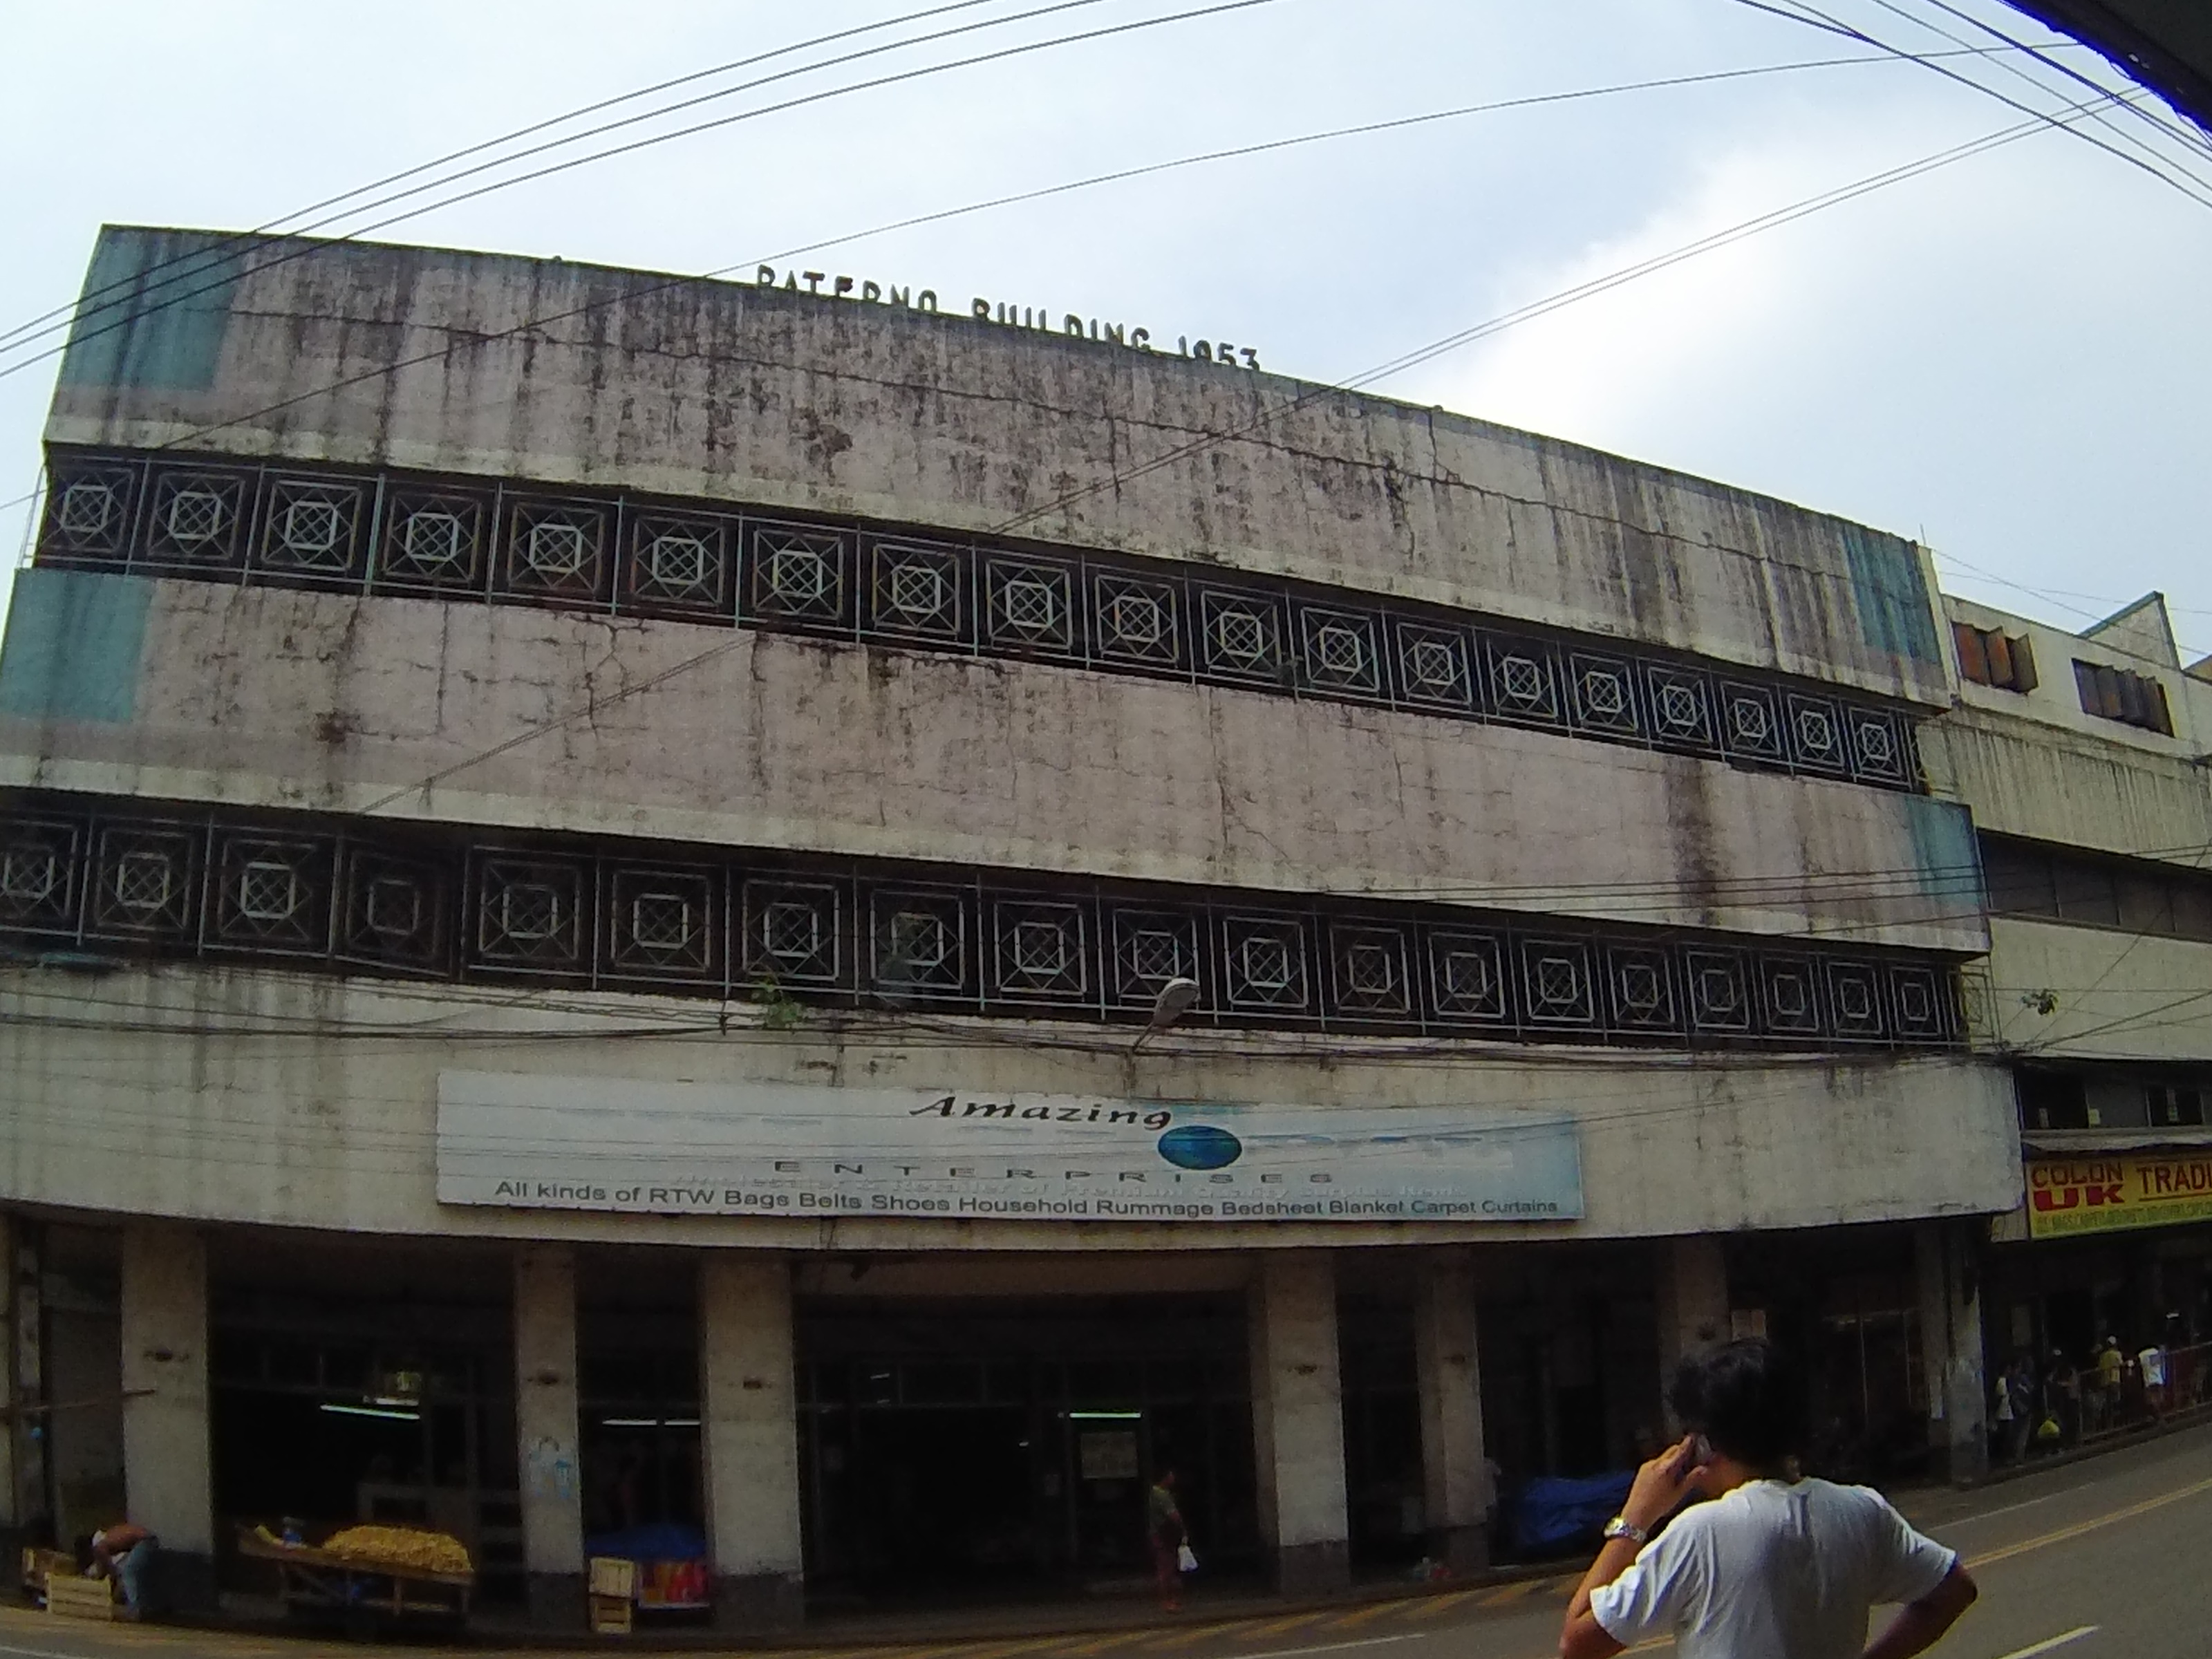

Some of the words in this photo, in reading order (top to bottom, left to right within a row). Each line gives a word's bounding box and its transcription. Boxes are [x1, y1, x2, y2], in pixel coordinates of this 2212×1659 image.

[758, 264, 937, 312] PATERNO
[1178, 336, 1260, 371] 1953
[909, 1094, 1172, 1131] Amazing
[774, 1161, 1333, 1183] ENTERPRISES
[2032, 1162, 2124, 1188] COLON
[494, 1181, 527, 1197] All
[537, 1183, 606, 1201] kinds
[615, 1187, 642, 1203] of
[649, 1188, 715, 1205] RTW
[724, 1190, 790, 1209] Bags
[799, 1192, 863, 1209] Belts
[871, 1194, 950, 1212] Shoes
[959, 1197, 1088, 1215] Household
[1096, 1199, 1214, 1218] Rummage
[1221, 1201, 1323, 1216] Bedsheet
[1329, 1200, 1403, 1215] Blanket
[1411, 1199, 1477, 1217] Carpet
[1481, 1199, 1558, 1214] Curtains
[2033, 1184, 2124, 1212] UK
